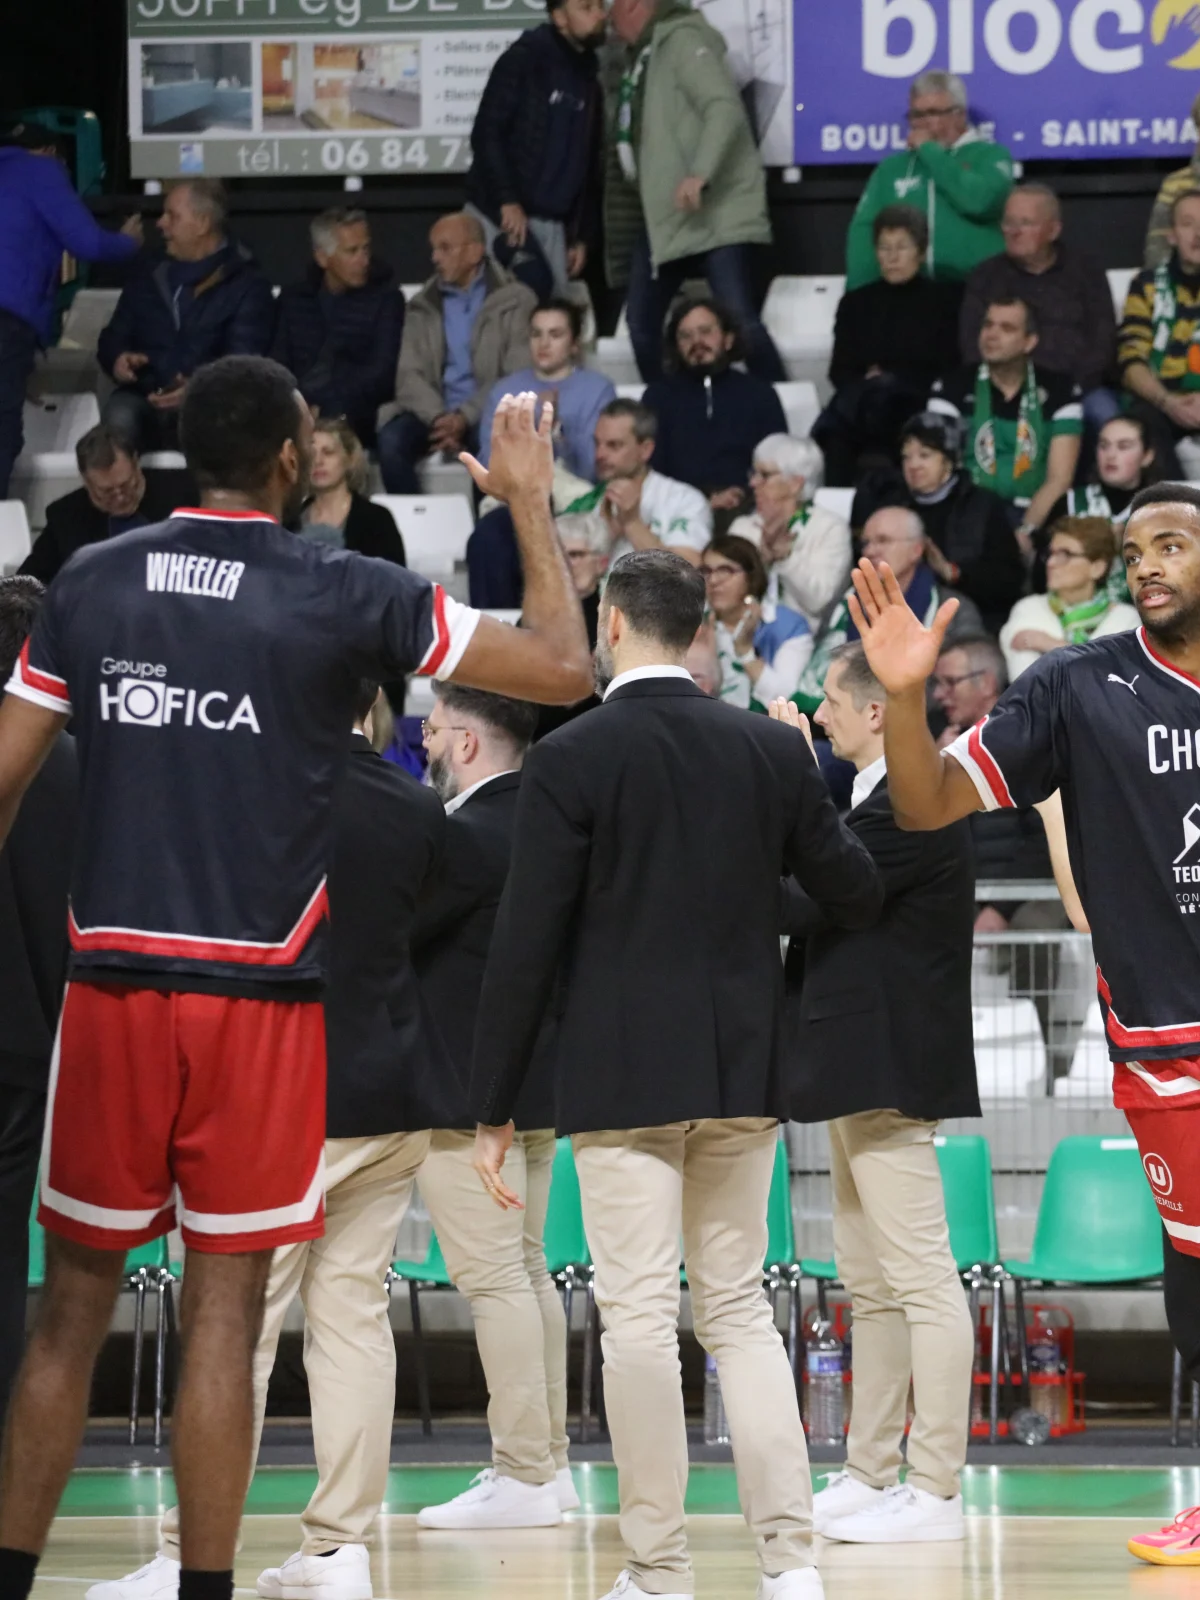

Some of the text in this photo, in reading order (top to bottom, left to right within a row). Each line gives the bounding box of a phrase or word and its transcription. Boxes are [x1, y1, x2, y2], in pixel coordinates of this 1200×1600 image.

[321, 138, 370, 171] 06
[380, 137, 429, 169] 84
[146, 552, 245, 600] WHEELER
[101, 656, 168, 678] Groupe
[100, 678, 261, 734] HOFICA
